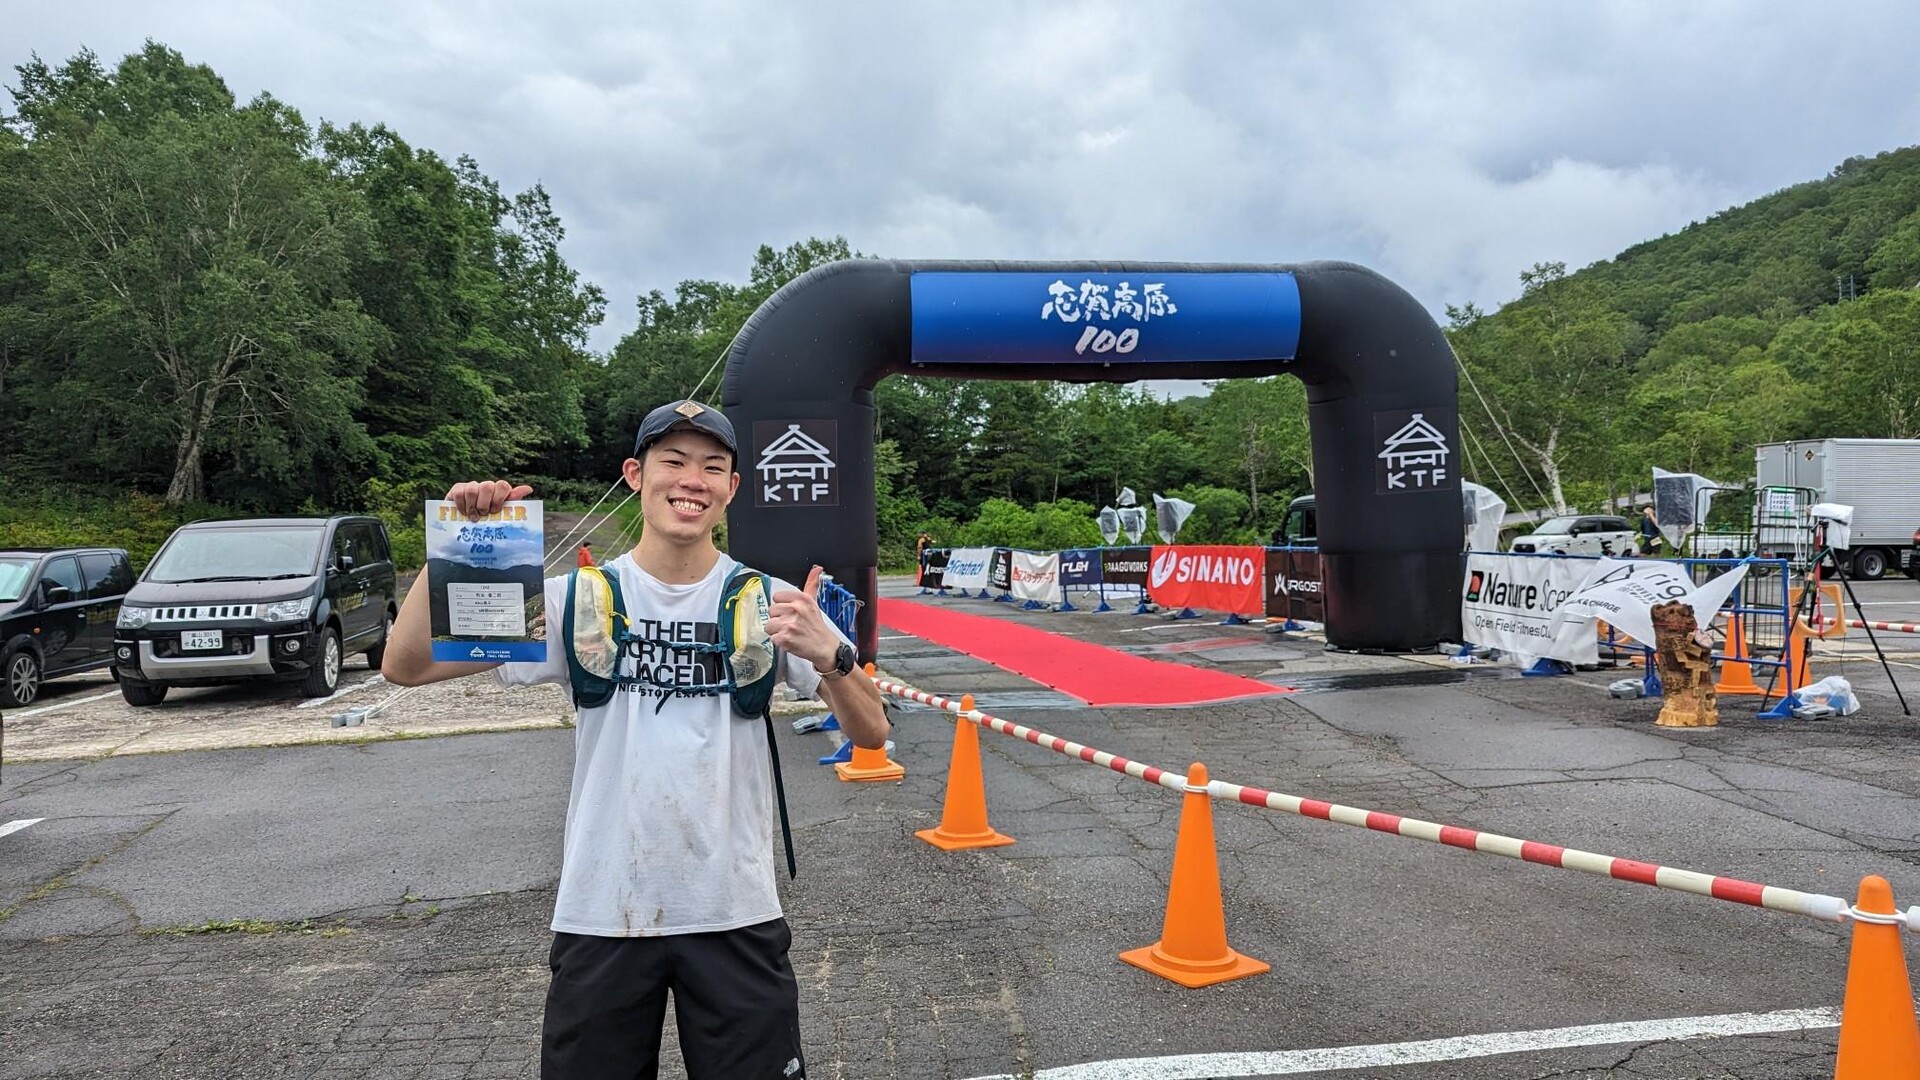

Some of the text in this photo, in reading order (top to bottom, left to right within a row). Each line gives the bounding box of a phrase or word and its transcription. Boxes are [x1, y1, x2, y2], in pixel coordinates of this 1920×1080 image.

[1040, 278, 1178, 323] 志賀高原
[1074, 325, 1140, 355] 100
[1387, 468, 1446, 490] KTF
[763, 483, 829, 502] KTF
[438, 506, 528, 521] FIHER
[456, 525, 508, 542] 志賀高原
[469, 542, 494, 554] 100
[1176, 555, 1255, 586] SINANO
[1483, 572, 1537, 610] Nature
[1643, 573, 1688, 600] rig
[1589, 599, 1621, 613] CHARGE
[639, 618, 693, 643] THE
[1475, 615, 1494, 630] Open
[1495, 618, 1517, 634] Field
[190, 637, 221, 648] 42-99
